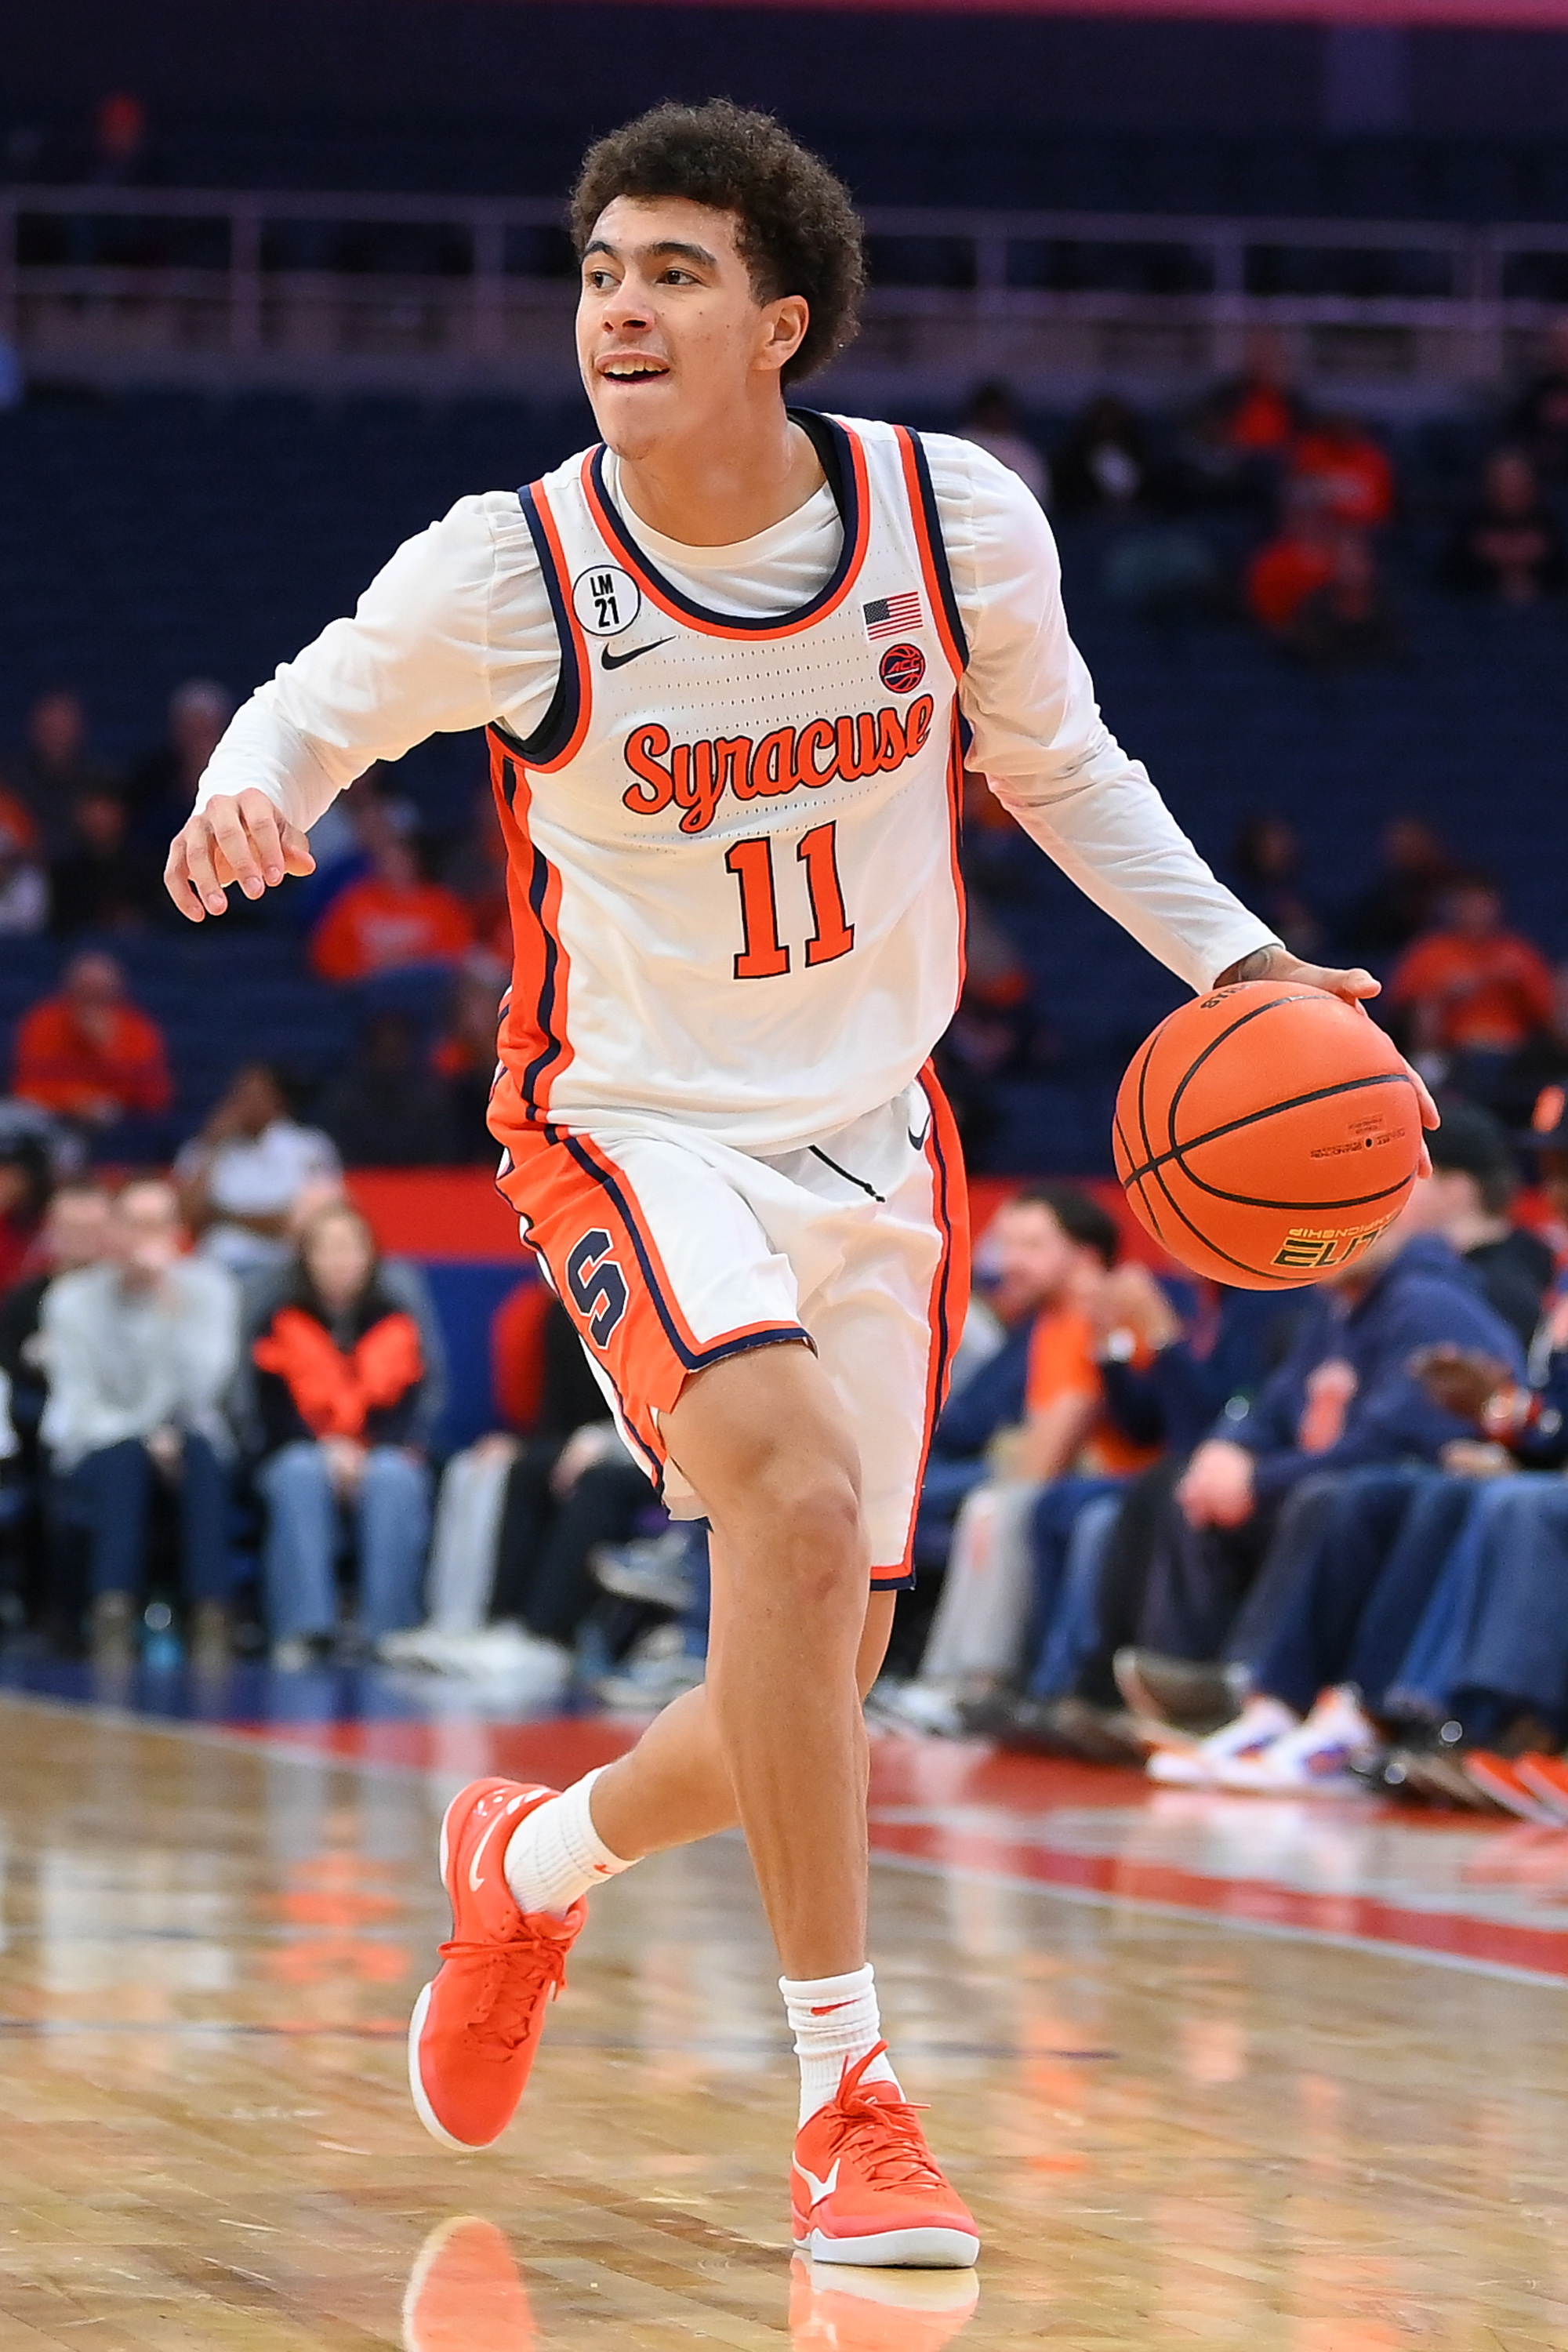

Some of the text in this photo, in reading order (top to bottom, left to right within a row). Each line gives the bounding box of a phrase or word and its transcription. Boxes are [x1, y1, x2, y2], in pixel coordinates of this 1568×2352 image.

[590, 573, 614, 597] LM
[594, 596, 620, 628] 21
[887, 657, 920, 673] ACC
[622, 693, 935, 833] Syracuse
[724, 819, 855, 980] 11
[566, 1228, 629, 1350] S
